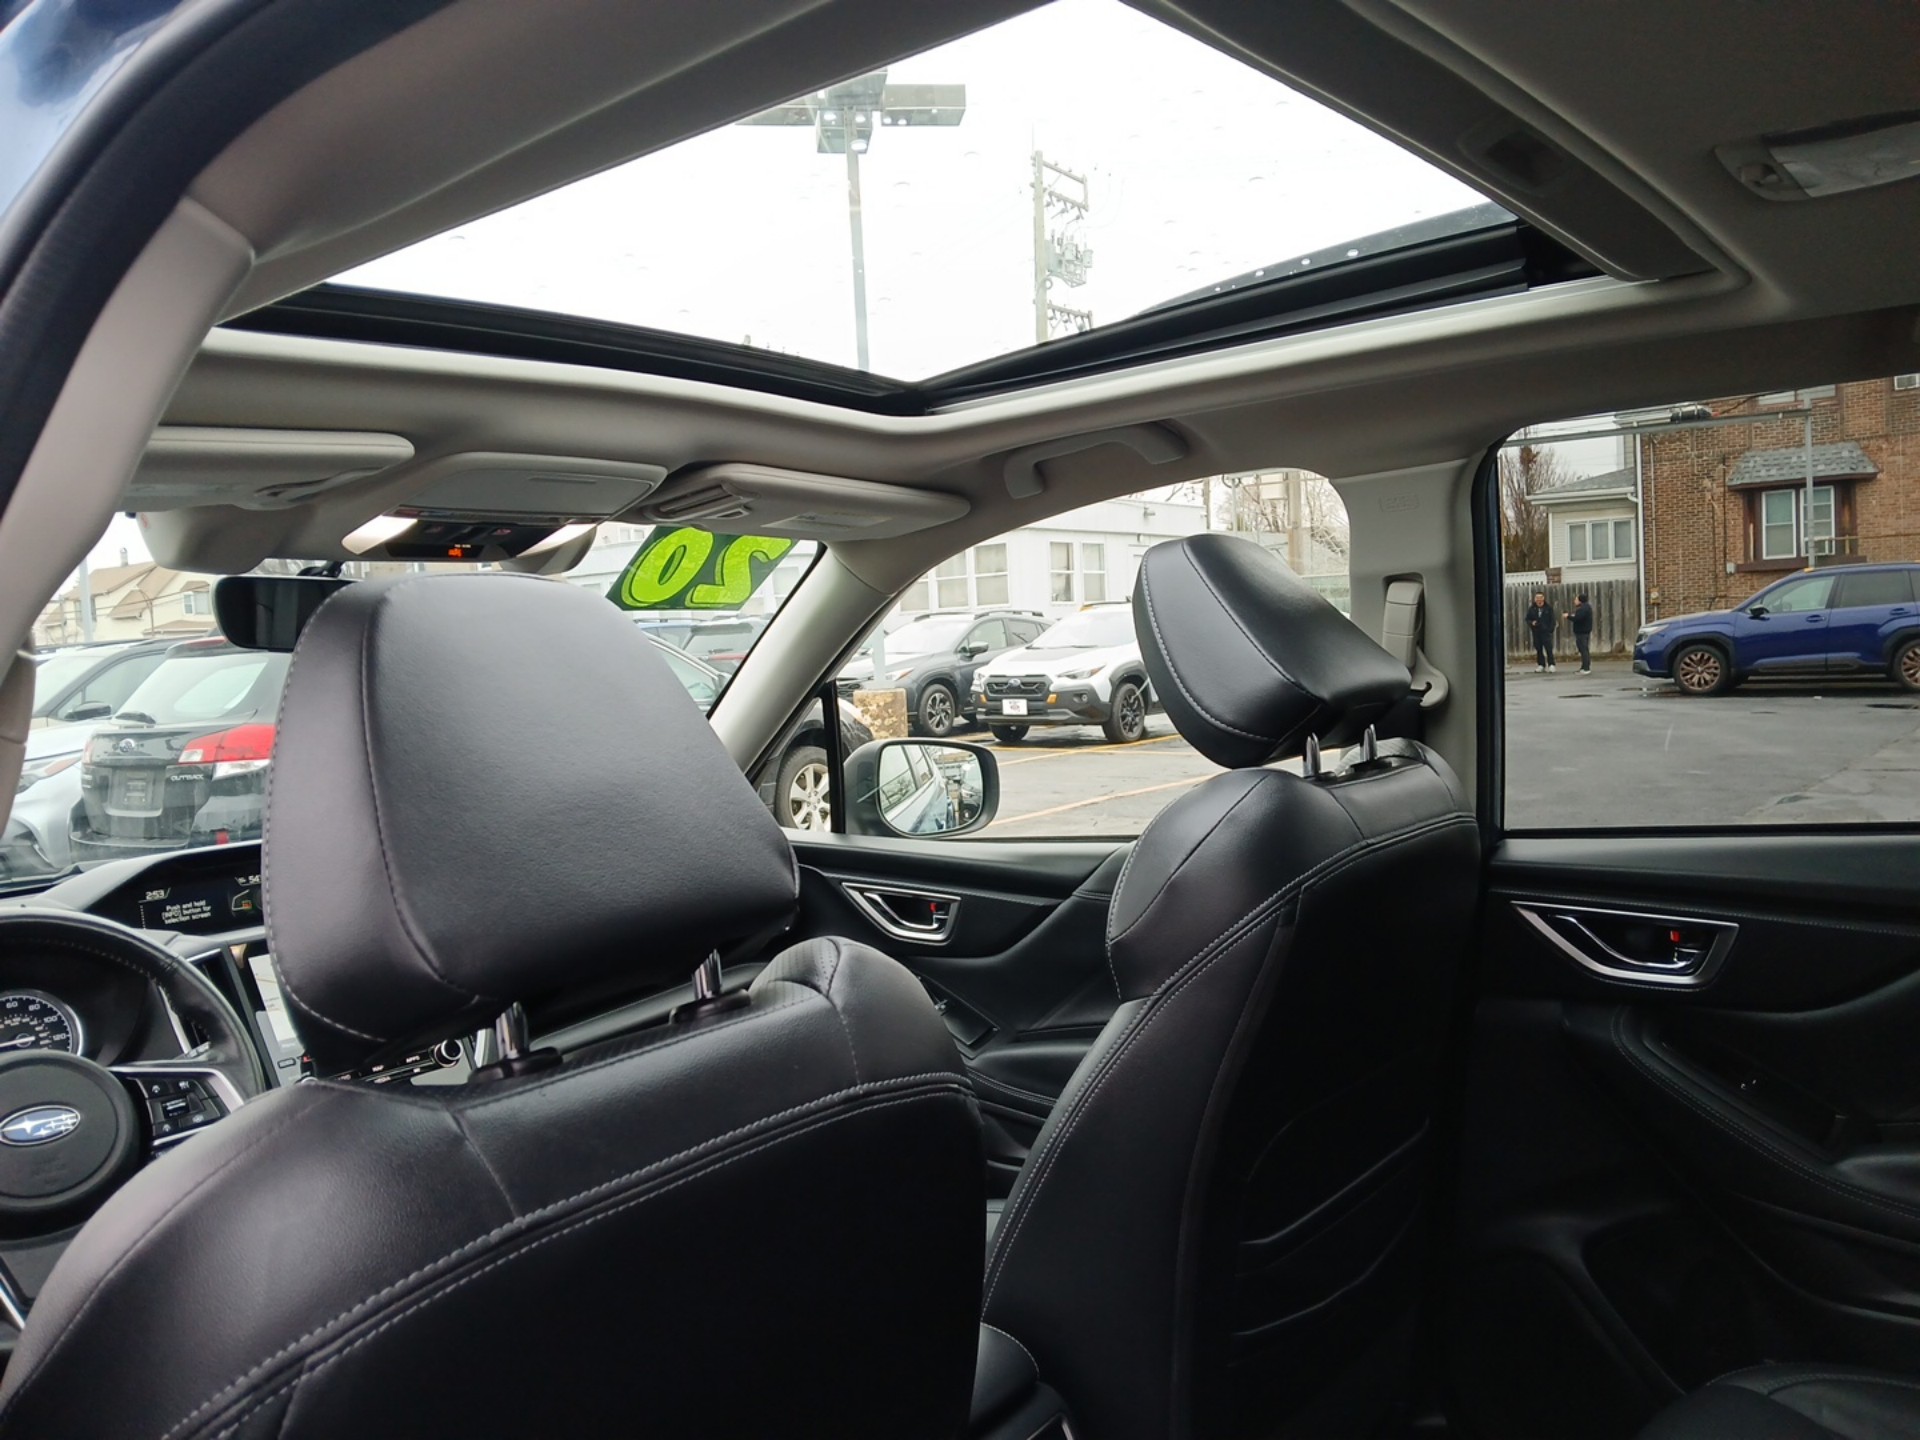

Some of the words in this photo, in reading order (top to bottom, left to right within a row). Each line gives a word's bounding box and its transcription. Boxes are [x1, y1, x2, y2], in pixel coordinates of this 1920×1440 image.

[170, 774, 204, 782] OUTBACK
[191, 912, 212, 920] screen
[6, 1001, 18, 1009] 60
[28, 1003, 41, 1011] 80
